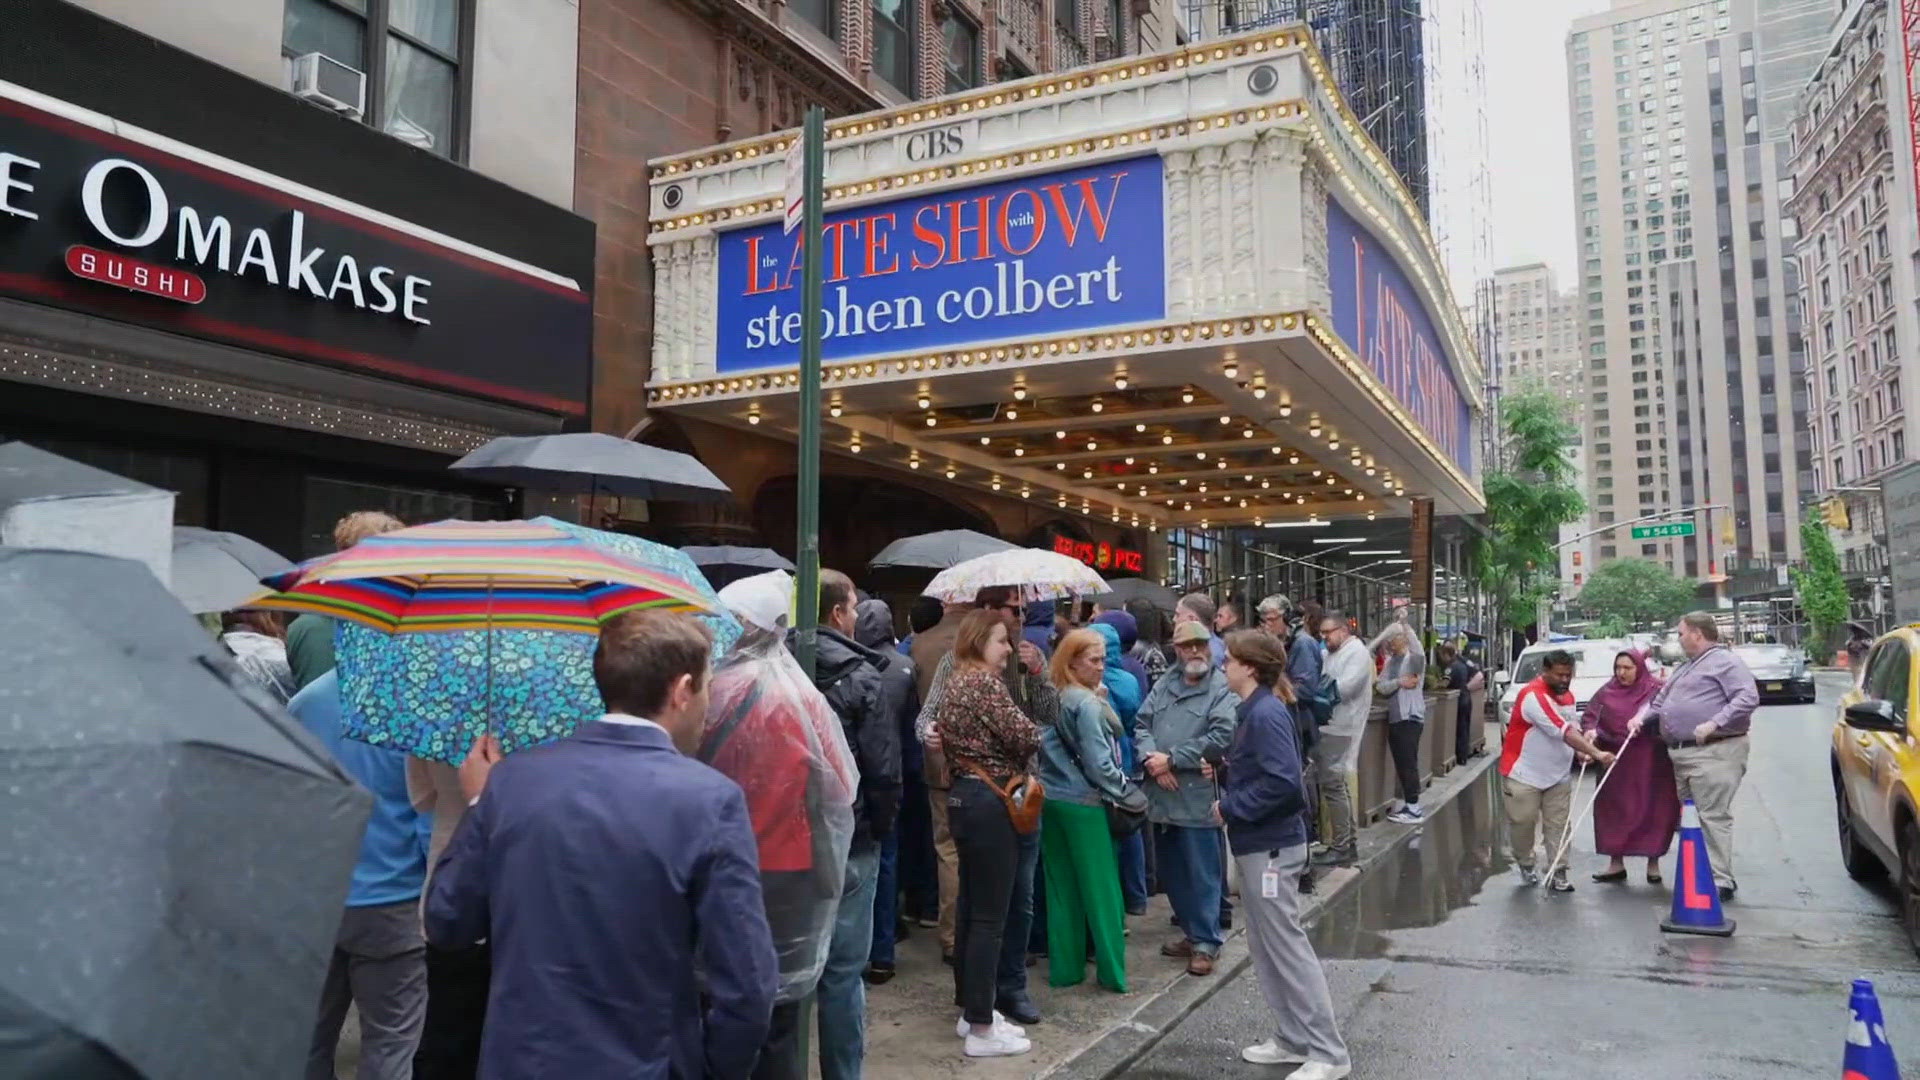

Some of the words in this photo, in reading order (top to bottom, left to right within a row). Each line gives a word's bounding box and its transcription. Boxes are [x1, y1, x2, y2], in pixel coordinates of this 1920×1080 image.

[906, 126, 963, 161] CBS
[910, 172, 1129, 271] SHOW
[1008, 211, 1035, 228] with
[81, 252, 189, 297] SUSHI
[762, 255, 778, 268] the
[936, 255, 1123, 323] colbert
[1641, 528, 1651, 537] W
[1654, 526, 1669, 536] 54
[1671, 525, 1682, 534] St
